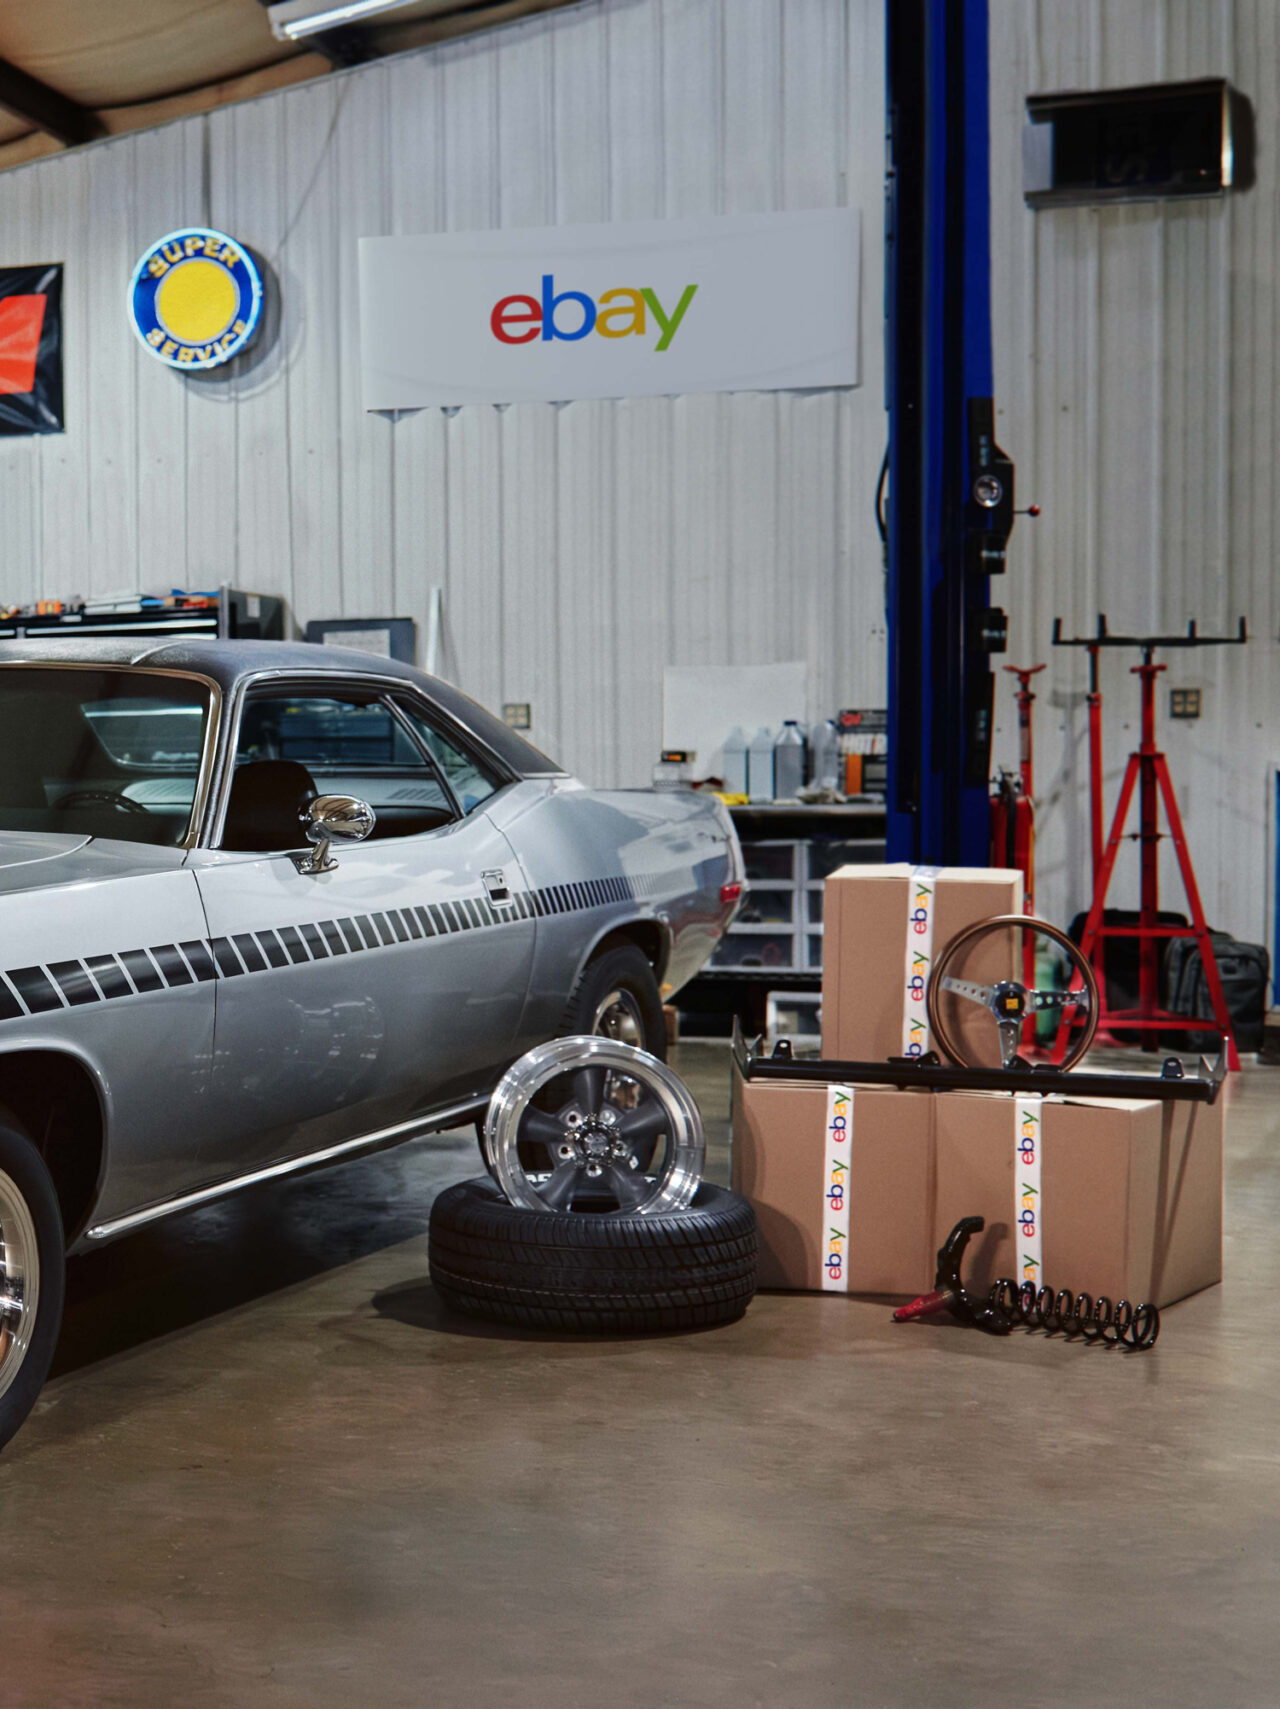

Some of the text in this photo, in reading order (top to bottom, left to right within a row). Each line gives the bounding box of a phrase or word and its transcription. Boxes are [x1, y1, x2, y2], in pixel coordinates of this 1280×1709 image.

[148, 236, 241, 278] SUPER
[489, 274, 699, 352] ebay
[145, 319, 247, 363] SERVICE
[910, 883, 933, 935] ebay
[907, 951, 930, 1002] ebay
[904, 1018, 927, 1060] bay
[828, 1091, 851, 1143] ebay
[1017, 1110, 1039, 1166] ebay
[826, 1159, 849, 1211] ebay
[1017, 1182, 1039, 1238] ebay
[824, 1227, 846, 1280] ebay
